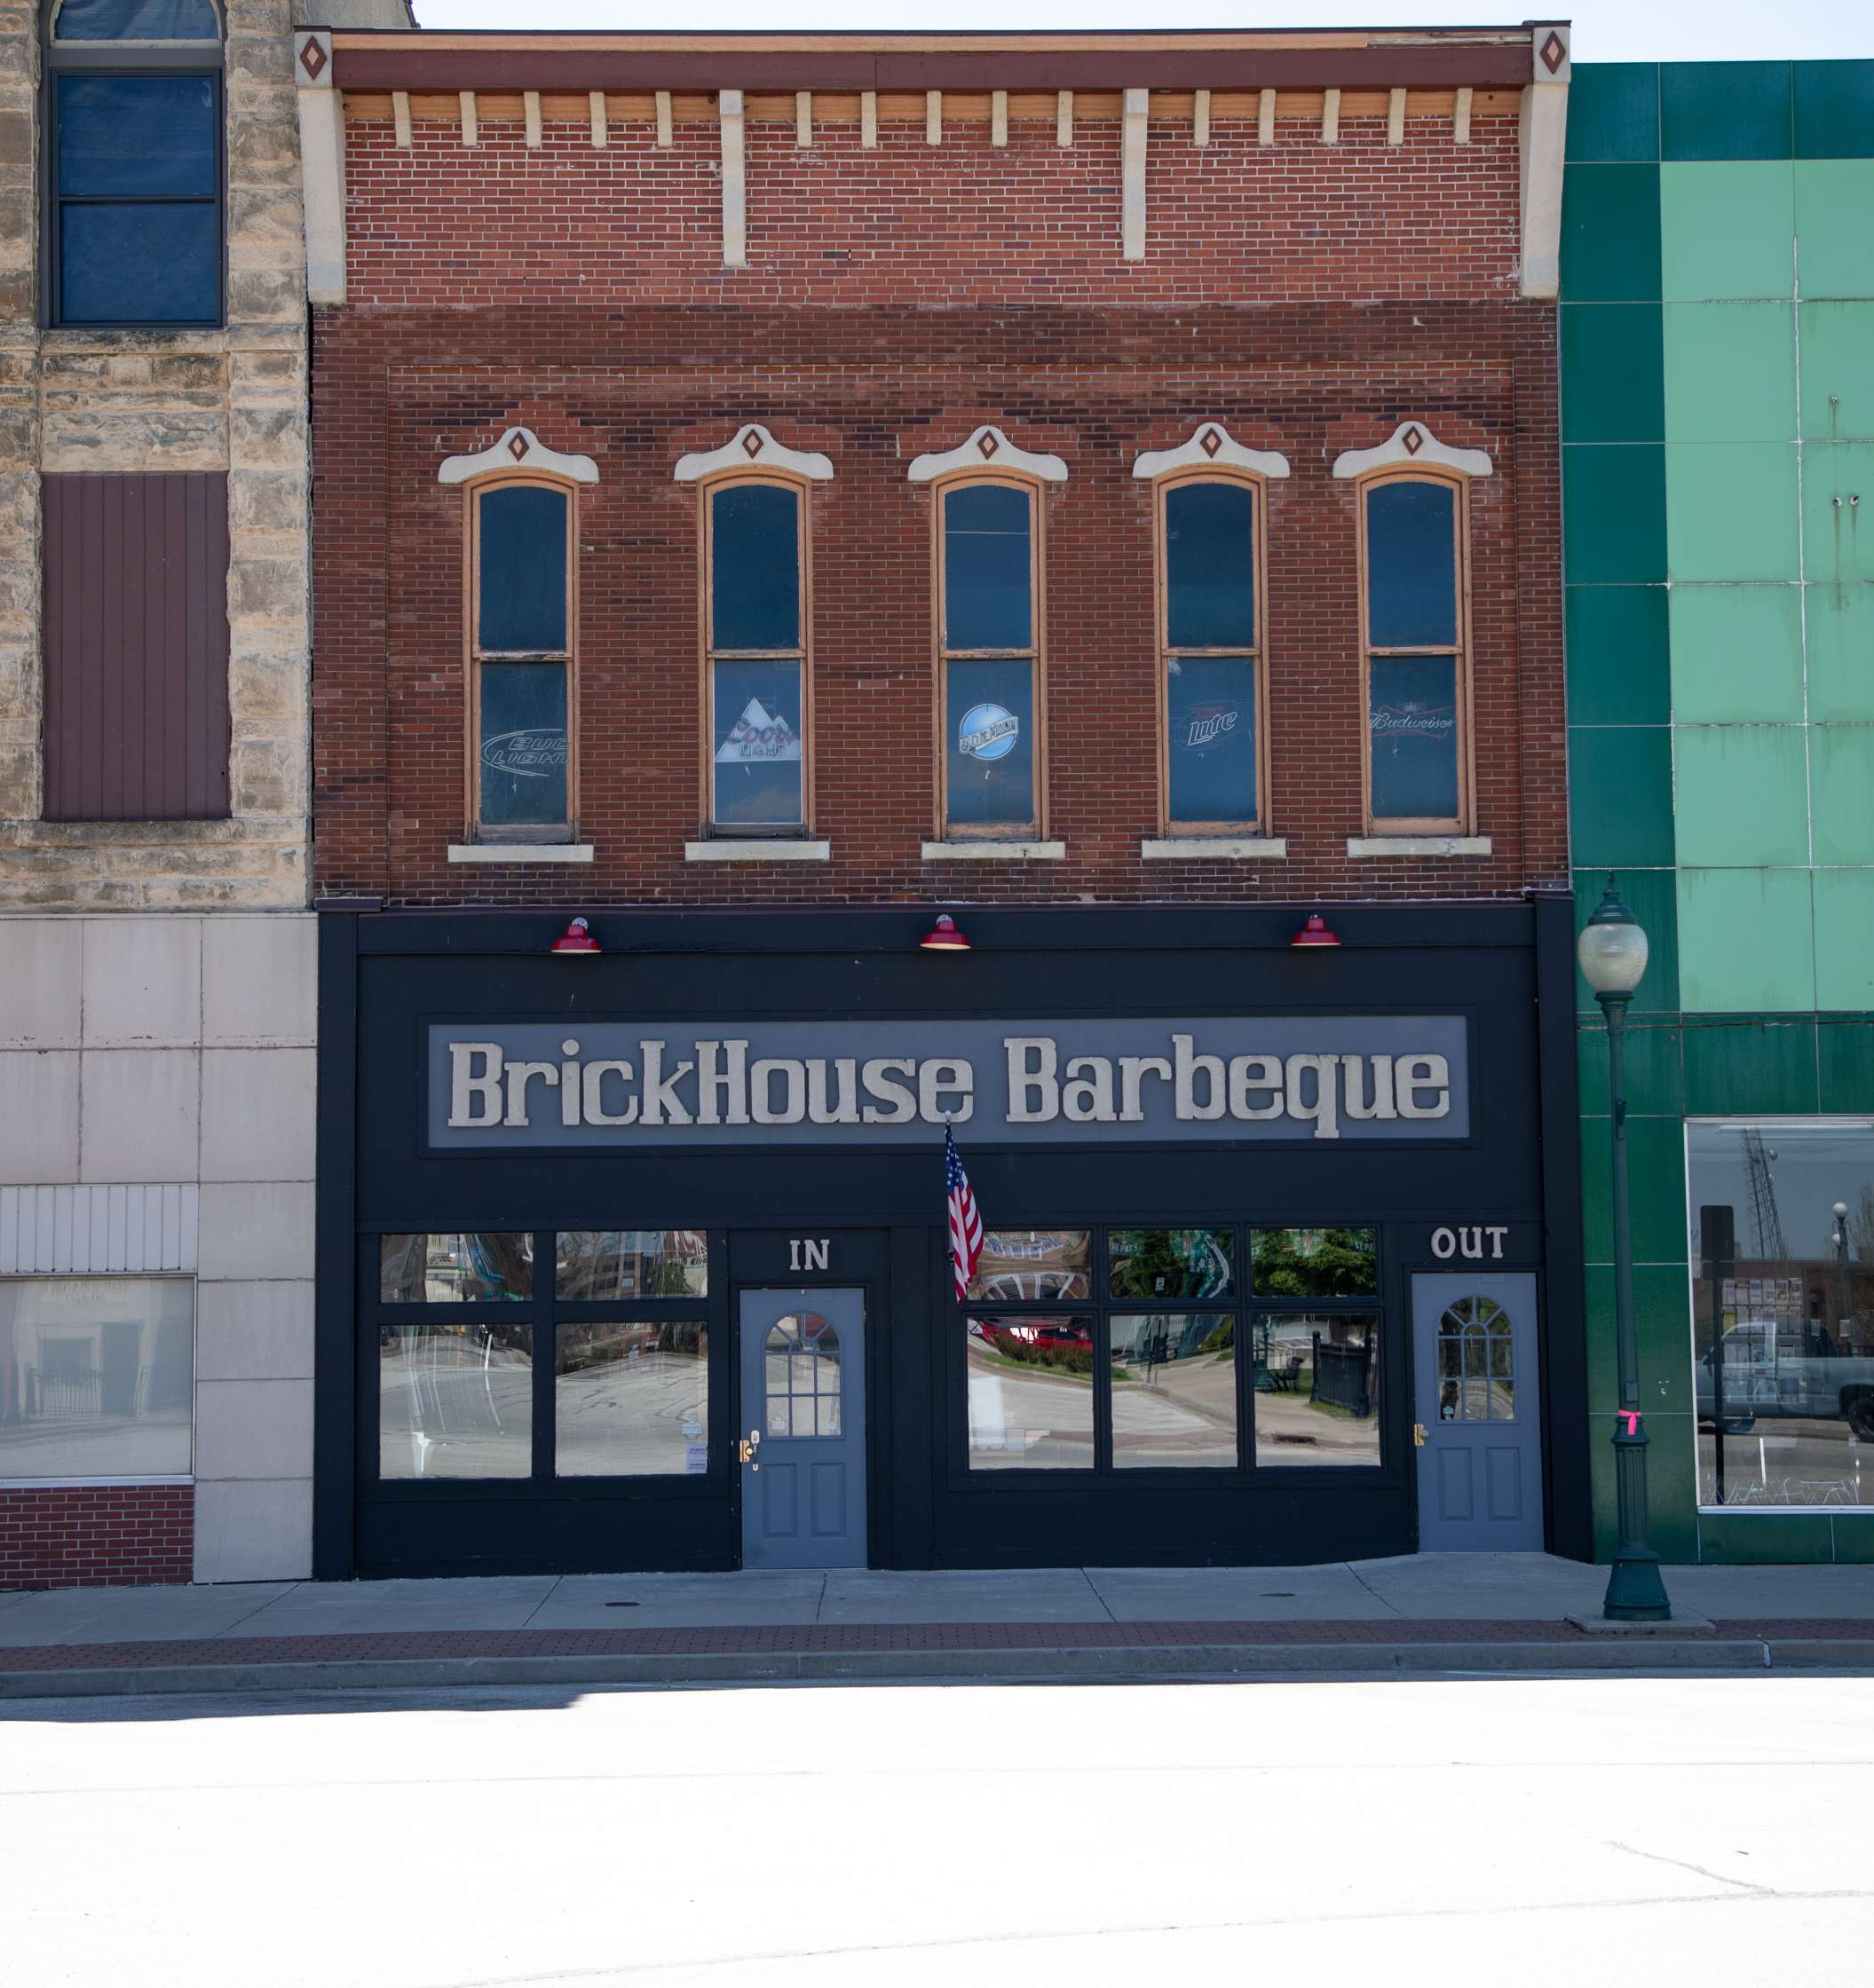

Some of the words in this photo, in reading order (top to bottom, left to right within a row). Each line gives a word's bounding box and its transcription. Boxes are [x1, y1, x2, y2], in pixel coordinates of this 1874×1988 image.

[1370, 712, 1454, 729] Budweiser
[509, 737, 568, 751] BUD
[739, 744, 785, 757] LIGHT
[448, 1038, 974, 1127] BrickHouse
[1003, 1034, 1450, 1139] Barbeque
[1431, 1227, 1508, 1258] OUT
[789, 1239, 830, 1271] IN
